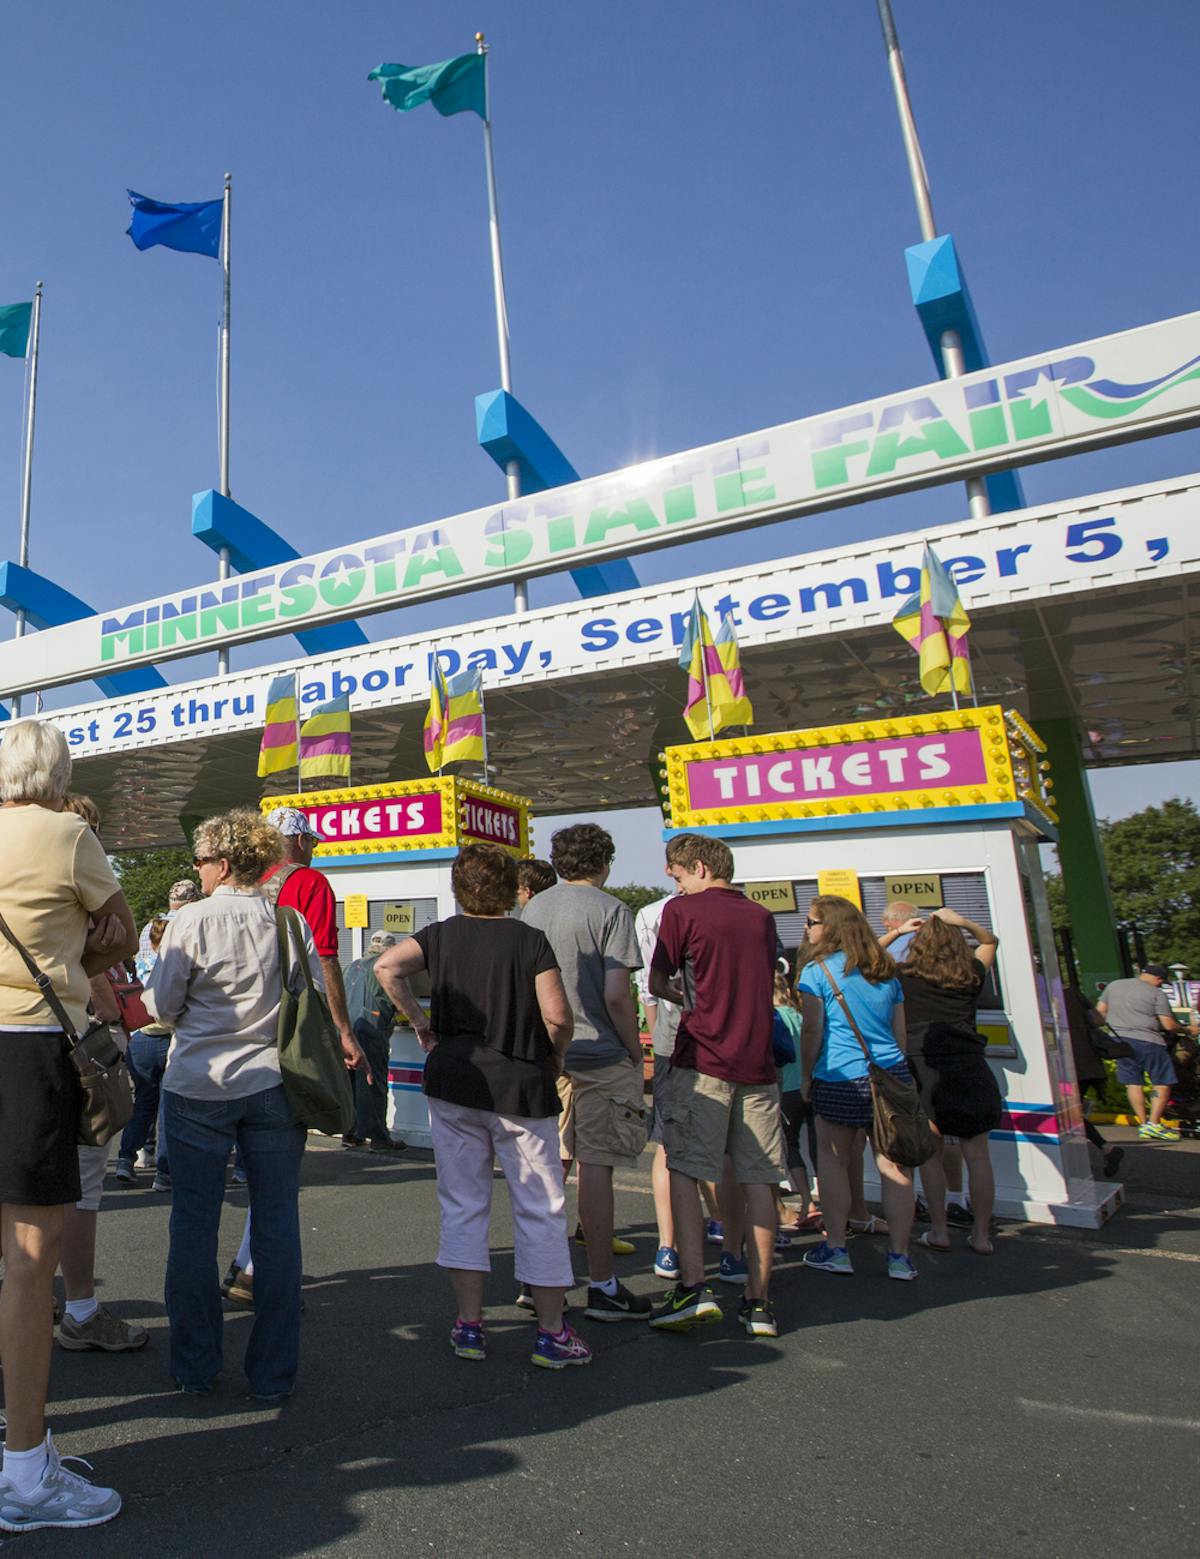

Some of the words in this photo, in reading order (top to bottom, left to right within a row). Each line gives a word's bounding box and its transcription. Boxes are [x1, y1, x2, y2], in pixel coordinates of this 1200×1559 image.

[101, 529, 464, 661] MINNESOTA
[484, 440, 776, 568] STATE
[808, 355, 1130, 490] FAIR
[112, 707, 157, 739] 25
[171, 694, 255, 727] thru
[301, 663, 414, 704] abor
[427, 640, 552, 678] Day,
[580, 544, 1033, 652] September
[713, 743, 951, 800] TICKETS
[308, 802, 425, 836] ICKETS
[463, 803, 516, 841] TICKETS
[751, 888, 789, 901] OPEN
[892, 882, 935, 895] OPEN
[386, 913, 410, 923] OPEN
